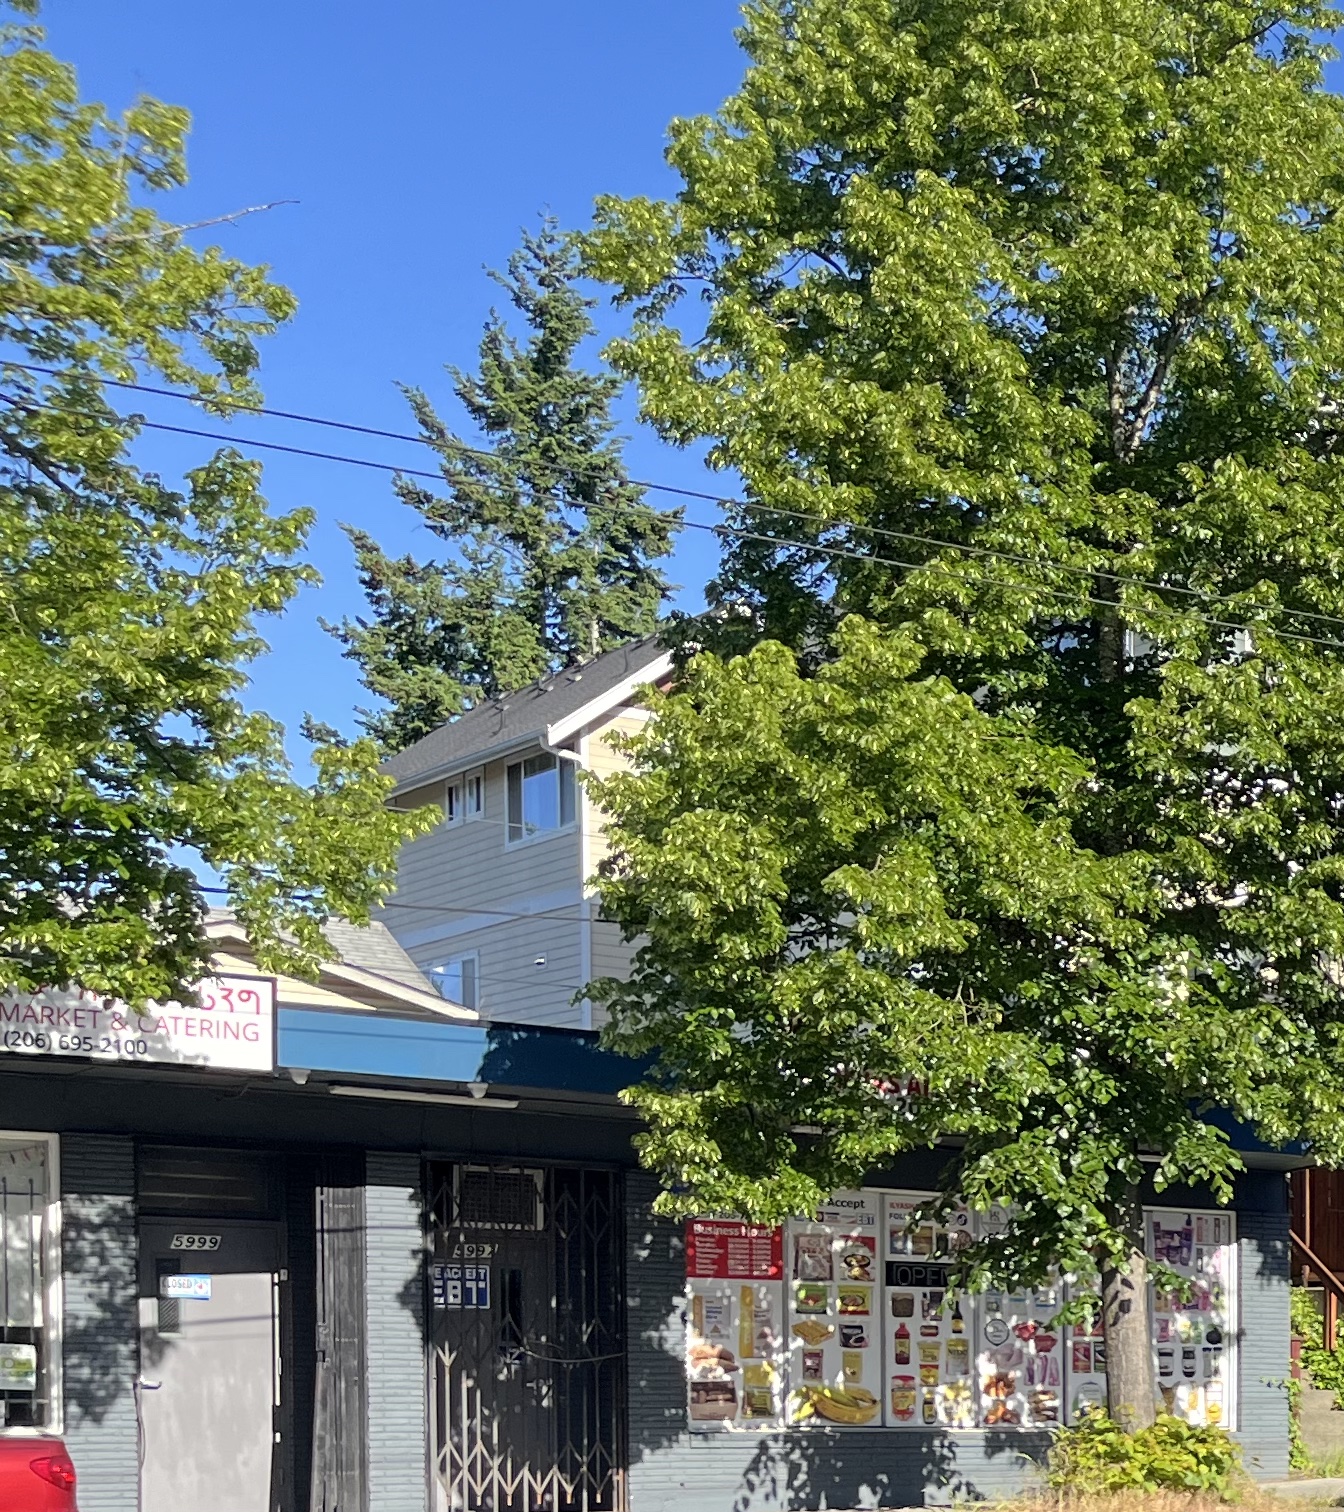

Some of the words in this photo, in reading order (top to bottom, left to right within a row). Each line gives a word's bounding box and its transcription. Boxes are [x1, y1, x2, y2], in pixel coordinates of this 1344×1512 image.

[0, 1002, 102, 1029] MARKET
[111, 1012, 127, 1031] &
[138, 1015, 260, 1042] CATERING
[3, 1030, 52, 1051] (206)
[59, 1034, 147, 1055] 695-2100
[827, 1197, 866, 1210] Accept
[693, 1223, 740, 1236] Business
[173, 1235, 219, 1249] 5999
[433, 1280, 486, 1305] EBT
